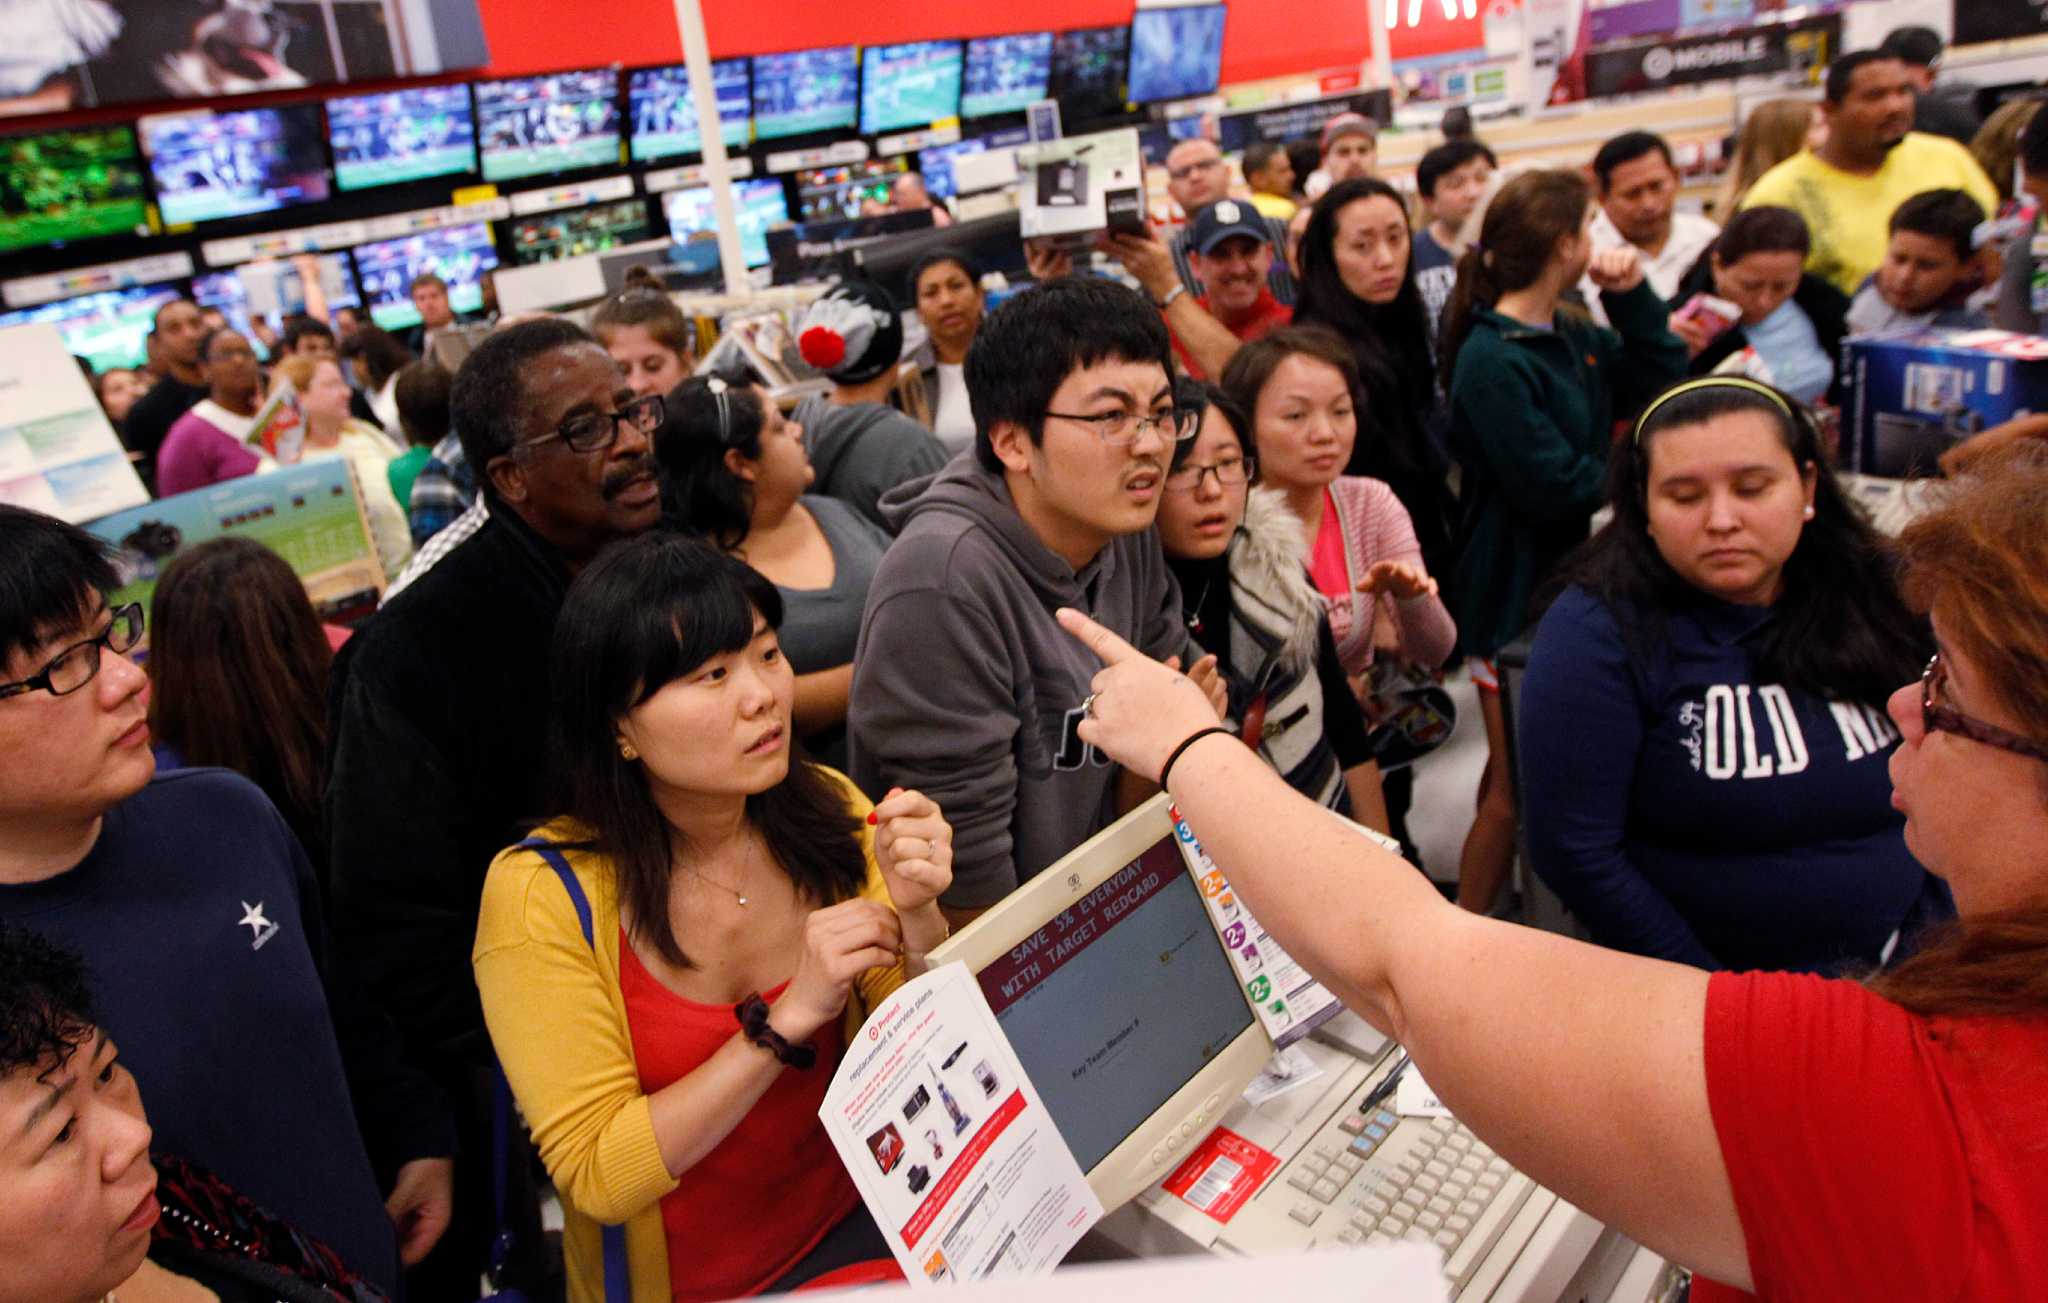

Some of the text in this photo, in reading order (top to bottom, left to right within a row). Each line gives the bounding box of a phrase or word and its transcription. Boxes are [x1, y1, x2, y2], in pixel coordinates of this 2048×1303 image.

[1674, 36, 1767, 69] MOBILE
[1705, 684, 1809, 779] OLD
[1000, 872, 1160, 998] WITH TARGET REDCARD
[1011, 858, 1143, 965] SAVE 5% EVERYDAY
[849, 988, 934, 1083] replacement & service plans
[1085, 1047, 1107, 1068] Team
